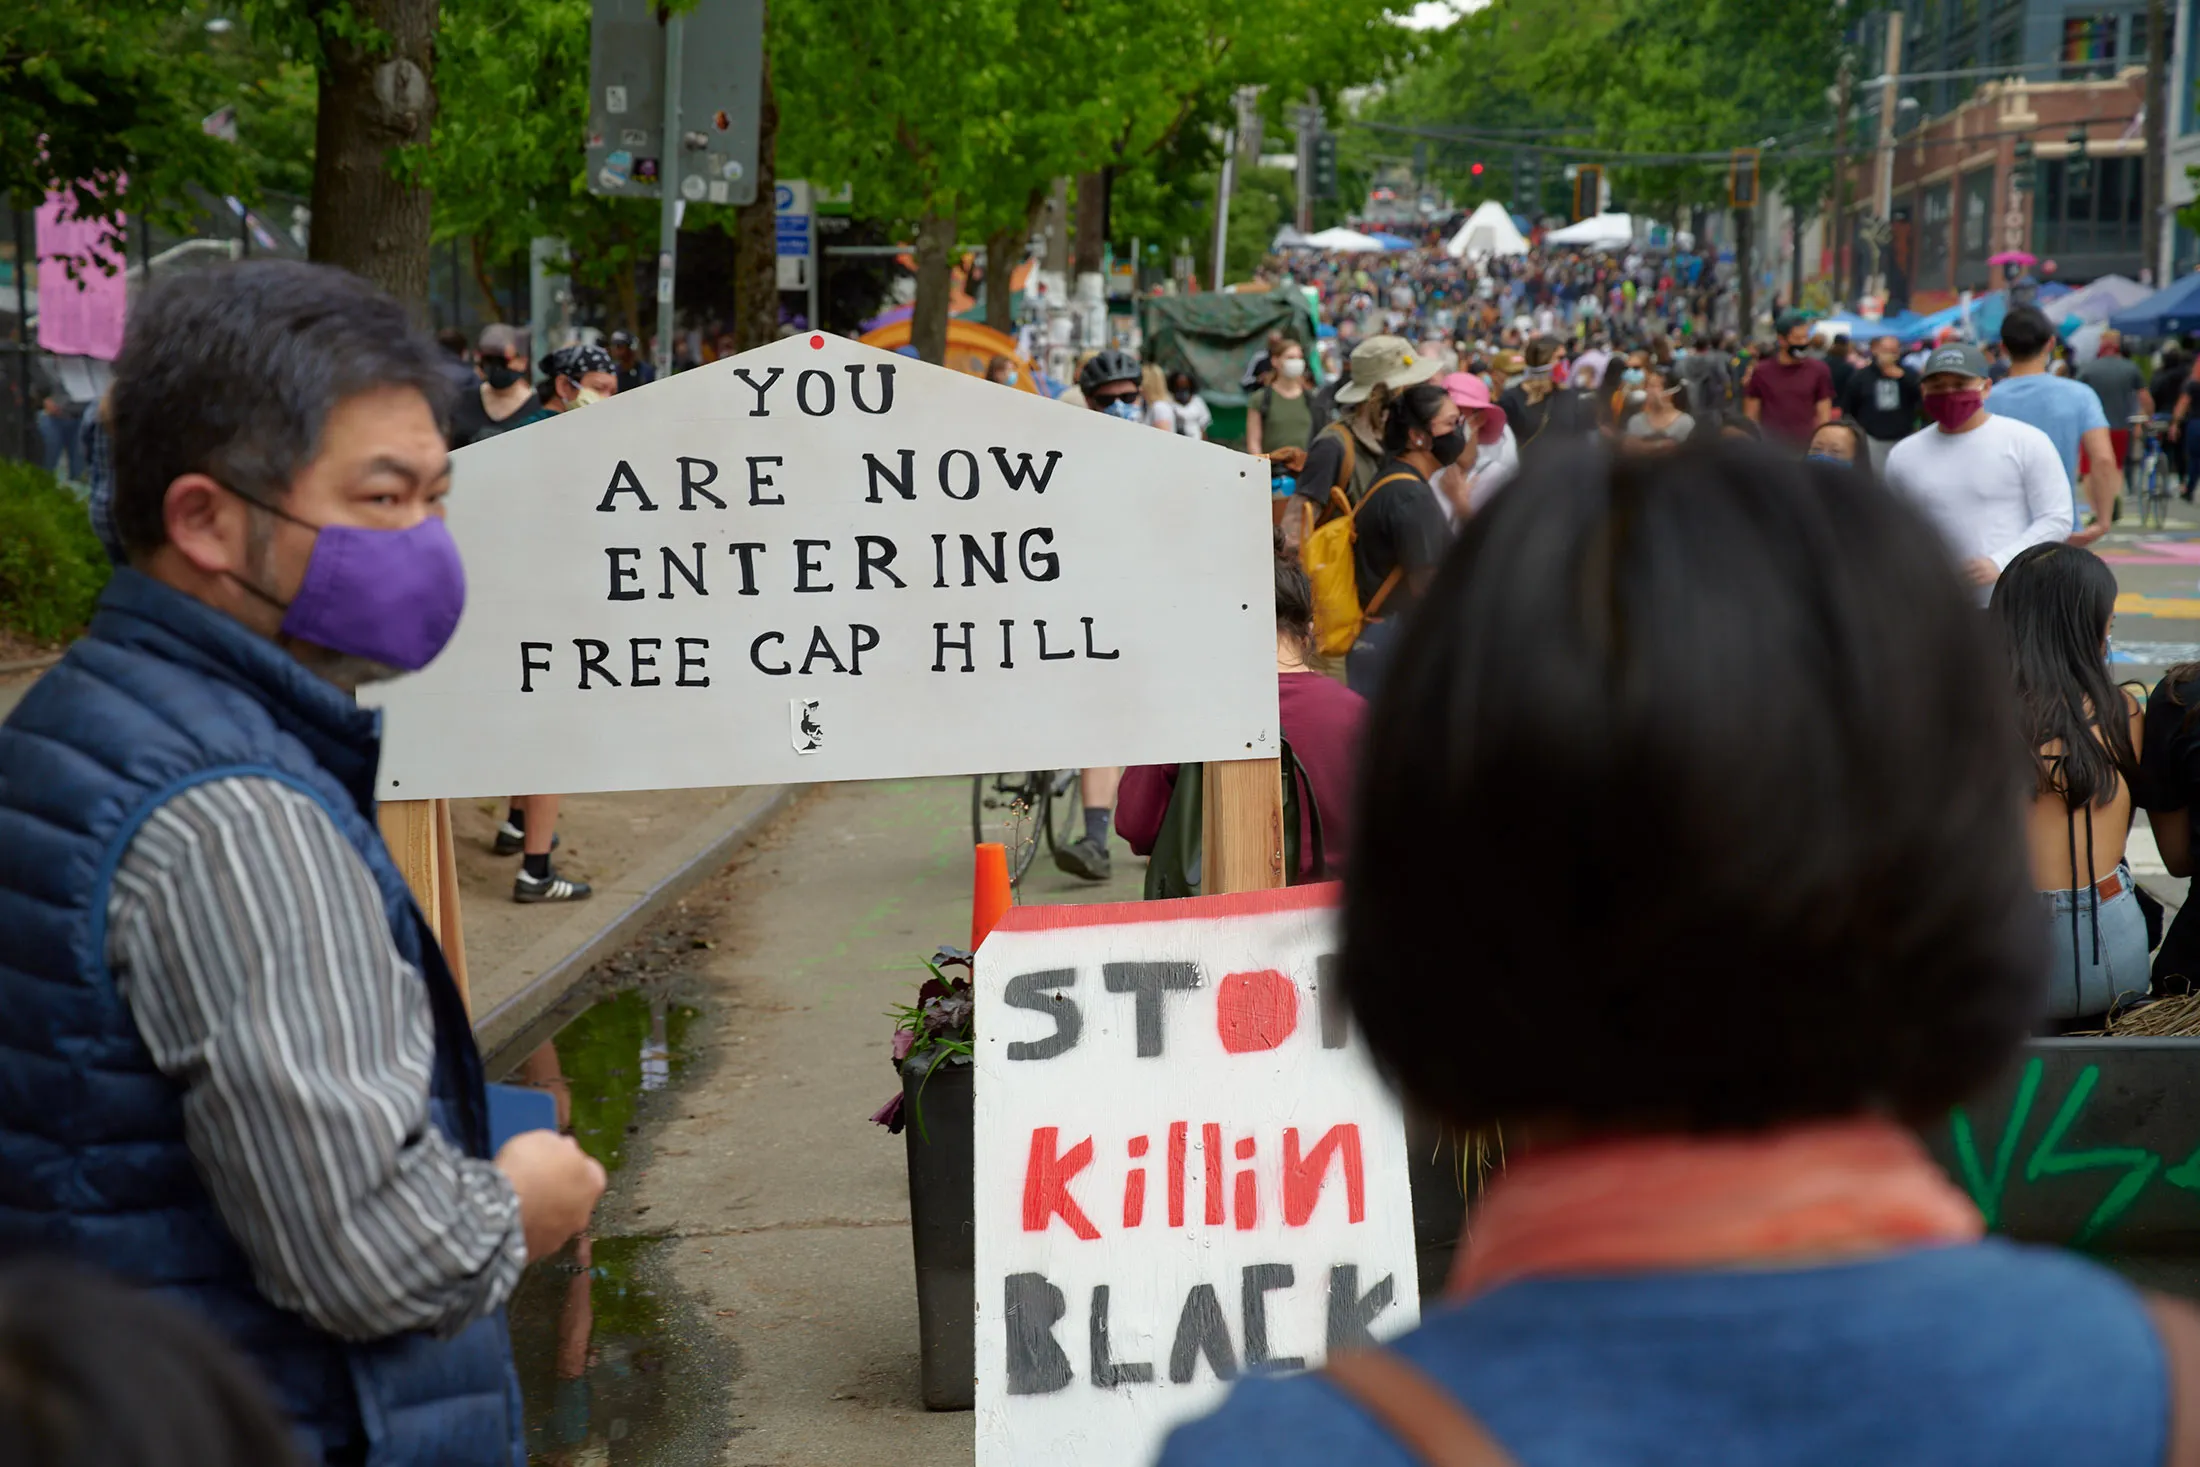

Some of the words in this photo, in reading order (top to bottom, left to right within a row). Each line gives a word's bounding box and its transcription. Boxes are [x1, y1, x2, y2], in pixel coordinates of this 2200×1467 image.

[733, 362, 898, 418] YOU
[595, 454, 787, 514] ARE
[861, 445, 1065, 505] NOW
[603, 525, 1062, 602] ENTERING
[519, 636, 711, 693] FREE
[749, 622, 881, 677] CAP
[930, 615, 1121, 674] HILL
[1003, 1262, 1396, 1396] BLACK
